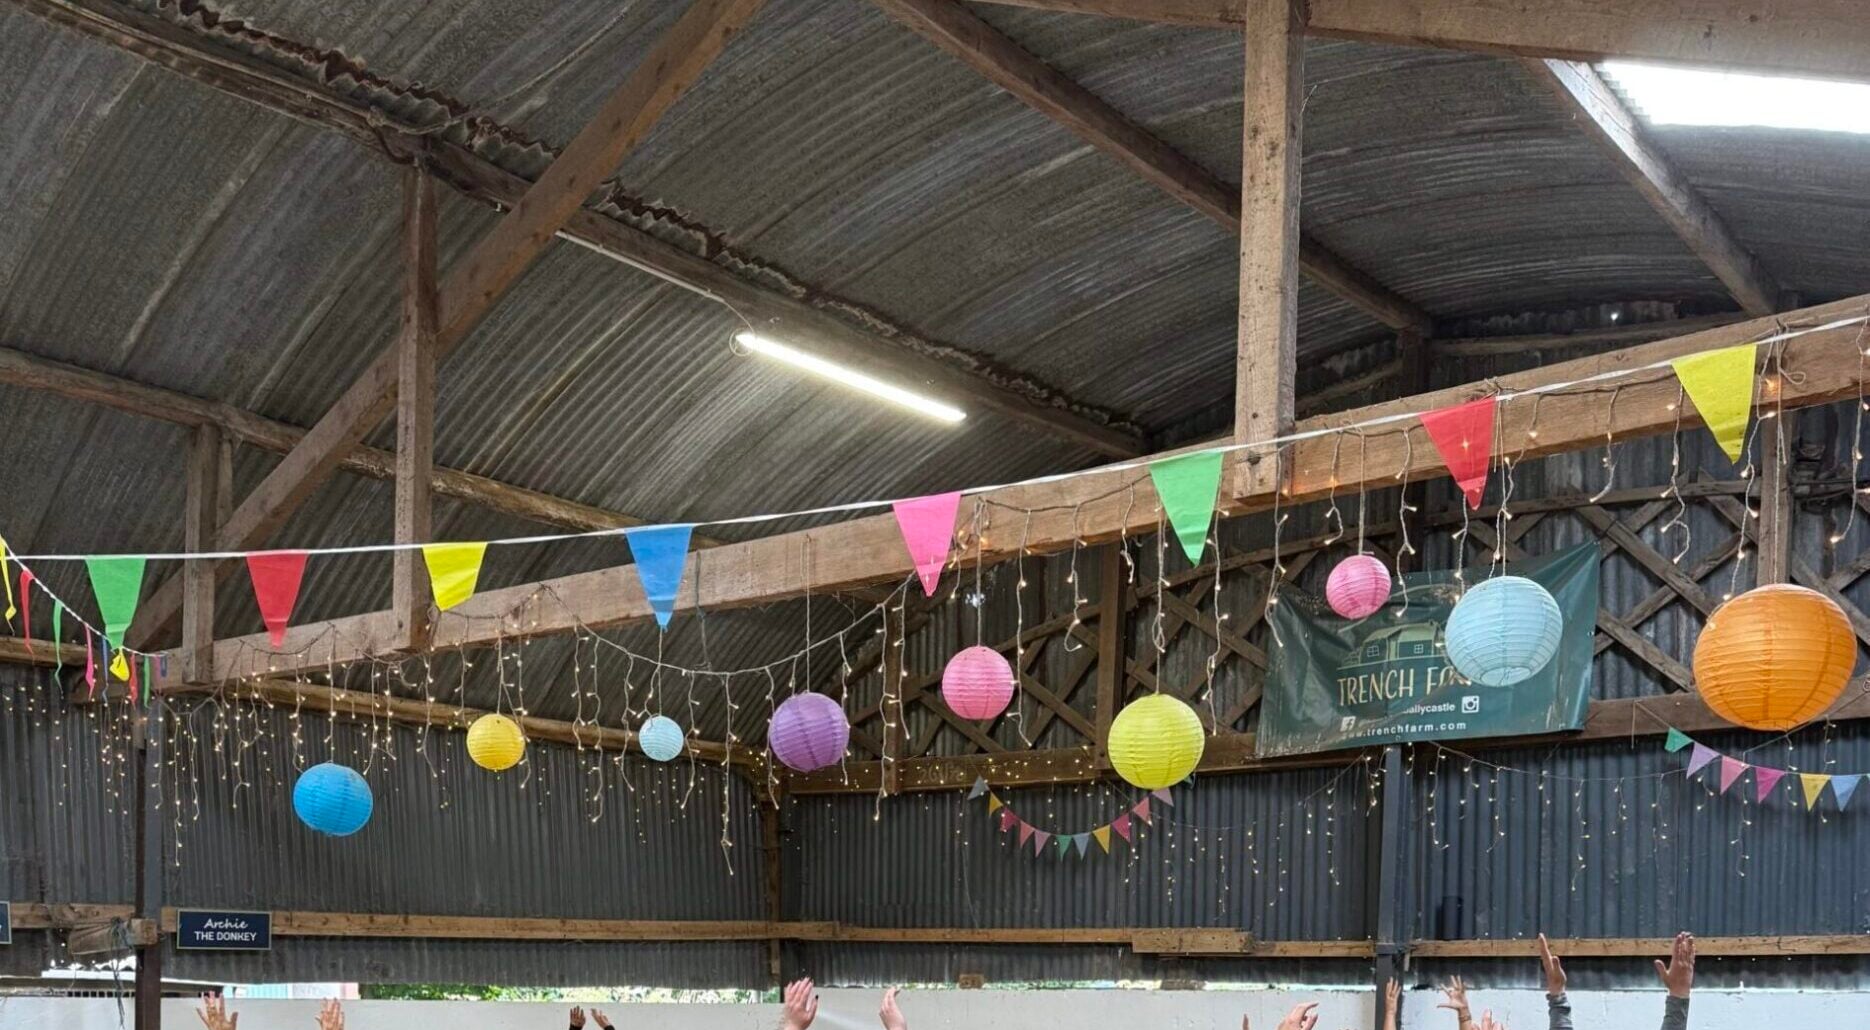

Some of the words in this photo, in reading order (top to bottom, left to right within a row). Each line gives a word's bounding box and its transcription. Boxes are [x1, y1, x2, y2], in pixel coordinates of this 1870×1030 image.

[1337, 667, 1415, 707] TRENCH
[203, 918, 248, 929] Archie
[194, 931, 214, 941] THE
[216, 931, 257, 942] DONKEY
